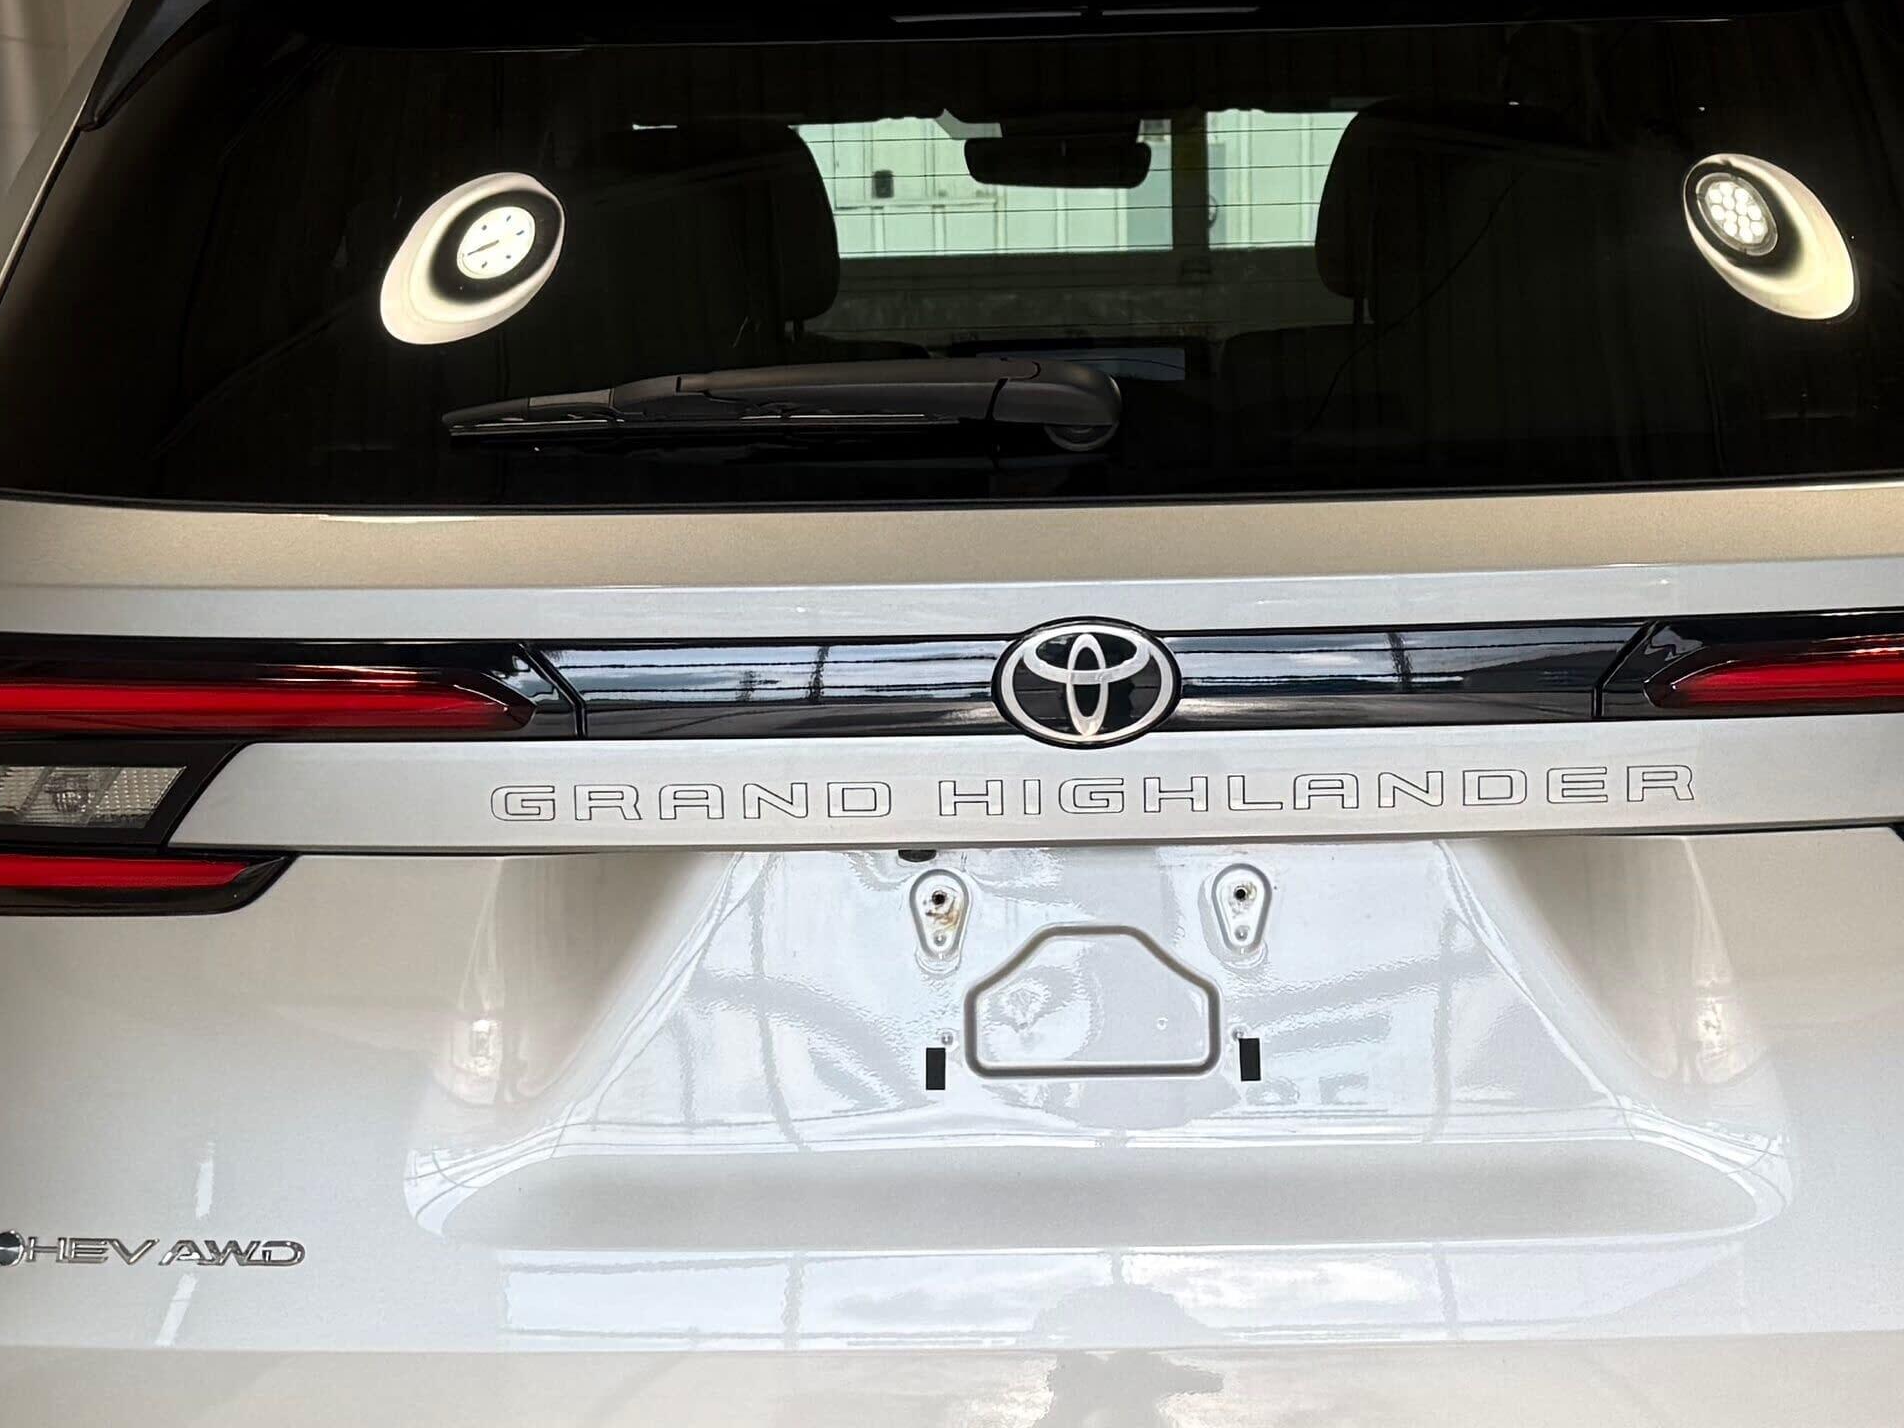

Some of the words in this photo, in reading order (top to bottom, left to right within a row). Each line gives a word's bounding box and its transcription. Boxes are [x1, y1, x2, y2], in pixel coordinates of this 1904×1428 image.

[490, 780, 893, 822] GRAND
[937, 764, 1696, 817] HIGHLANDER
[157, 1239, 307, 1267] AWD
